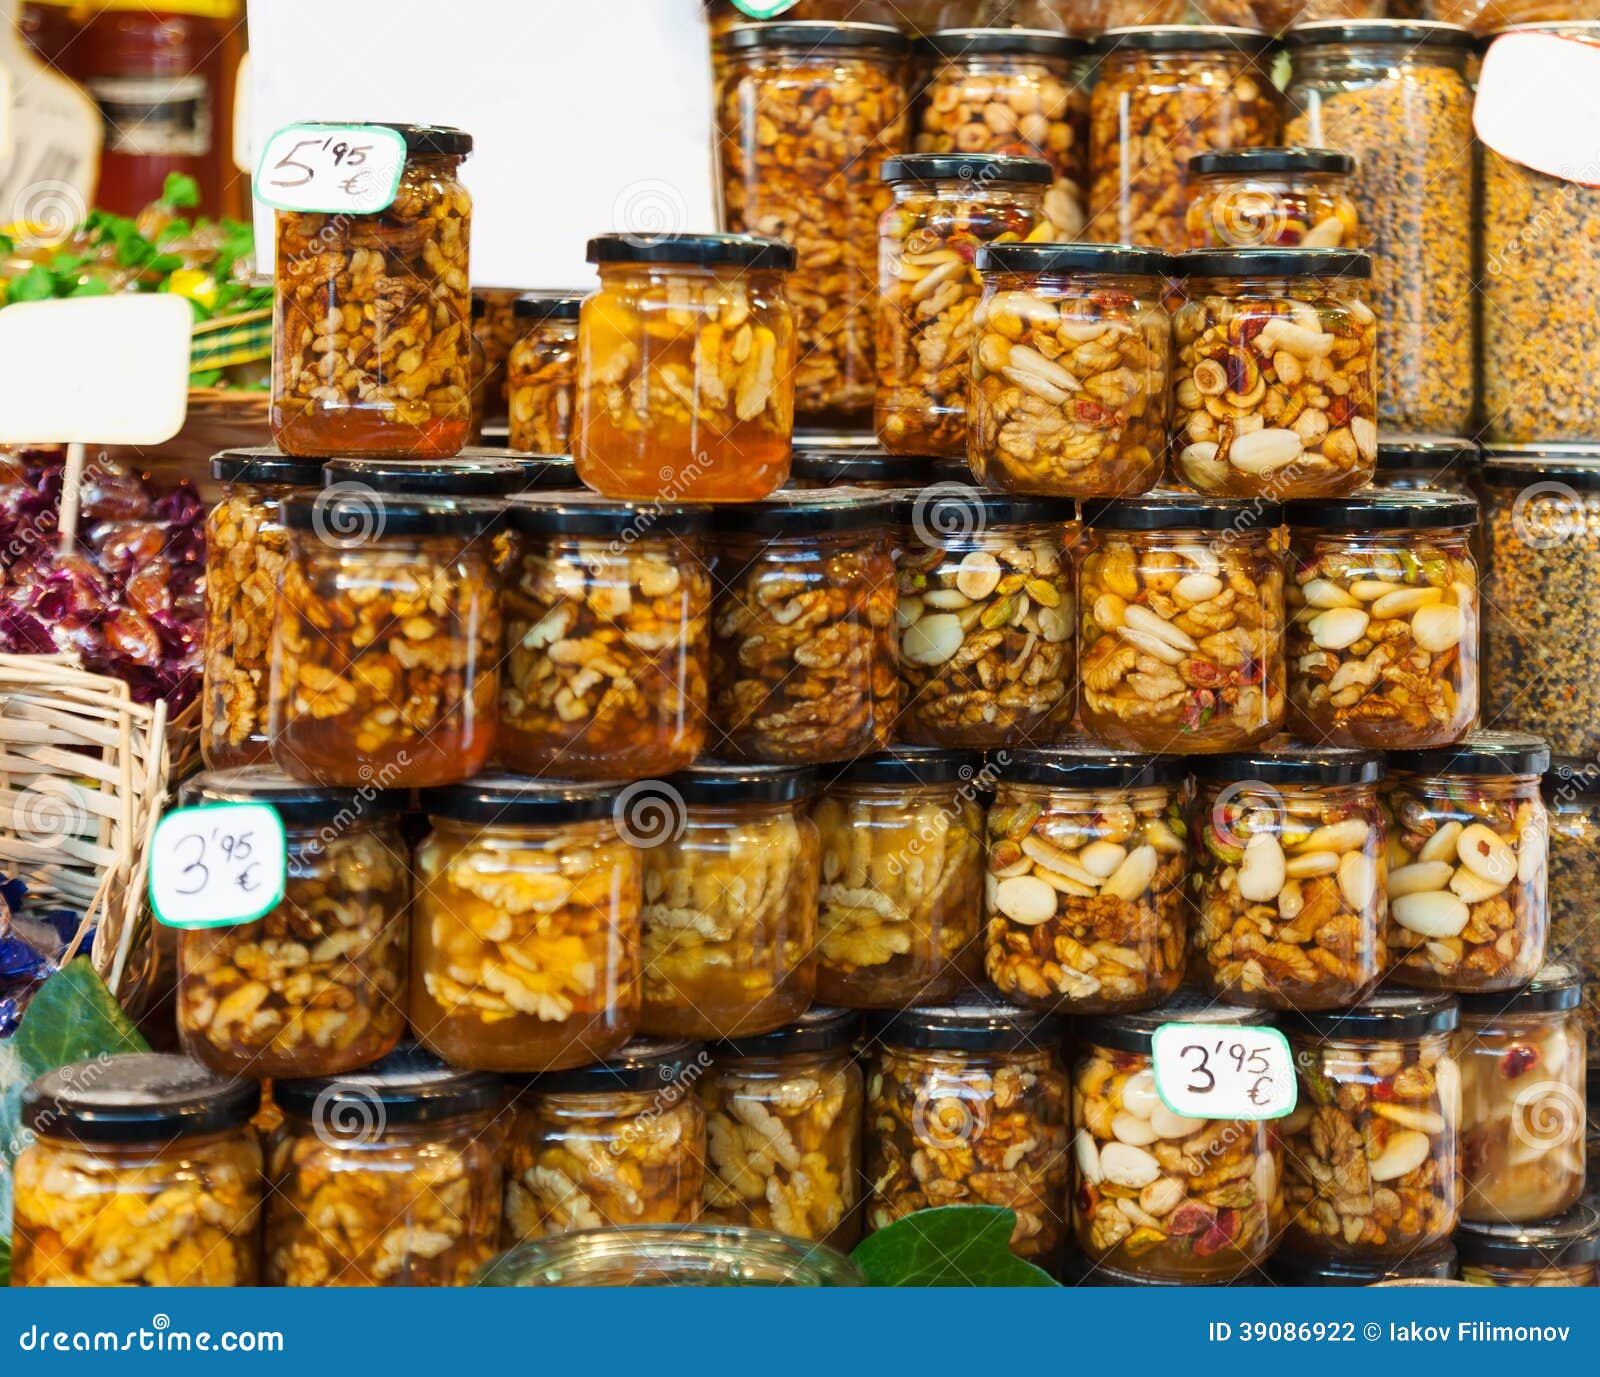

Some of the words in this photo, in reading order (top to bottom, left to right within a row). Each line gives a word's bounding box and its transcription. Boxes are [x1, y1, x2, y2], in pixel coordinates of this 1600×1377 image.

[338, 170, 369, 195] €
[234, 862, 262, 892] €
[1246, 1076, 1274, 1106] €
